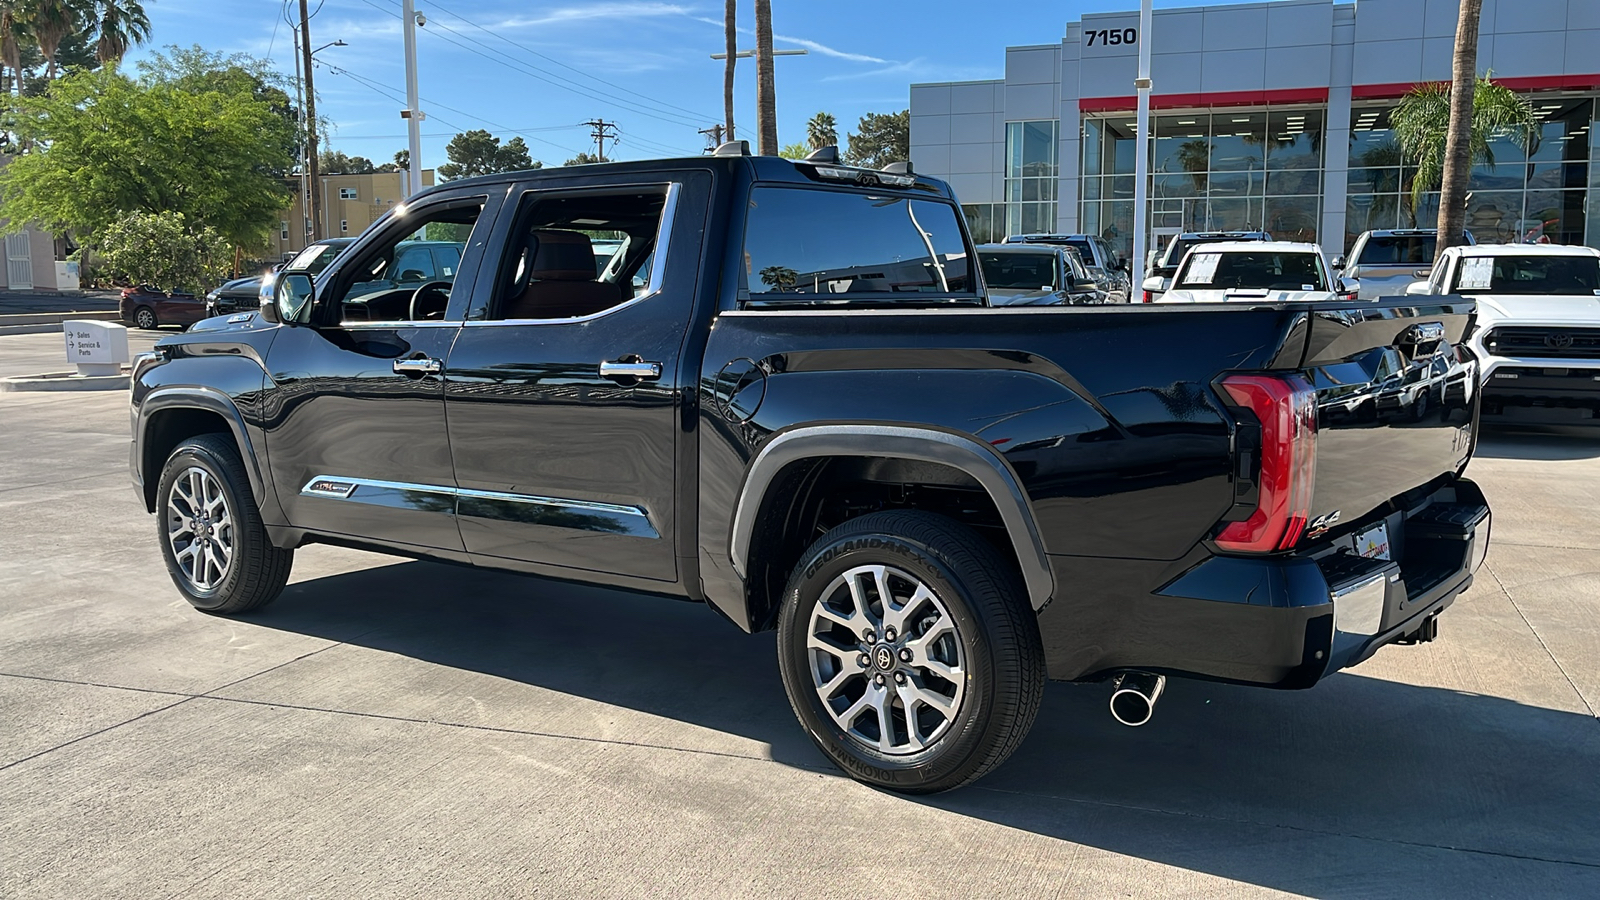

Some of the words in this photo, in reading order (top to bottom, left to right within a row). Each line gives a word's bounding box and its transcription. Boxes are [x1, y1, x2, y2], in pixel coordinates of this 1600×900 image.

[1085, 28, 1137, 47] 7150
[805, 538, 911, 580] GEOLANDAR
[830, 742, 900, 783] YOKOHAMA
